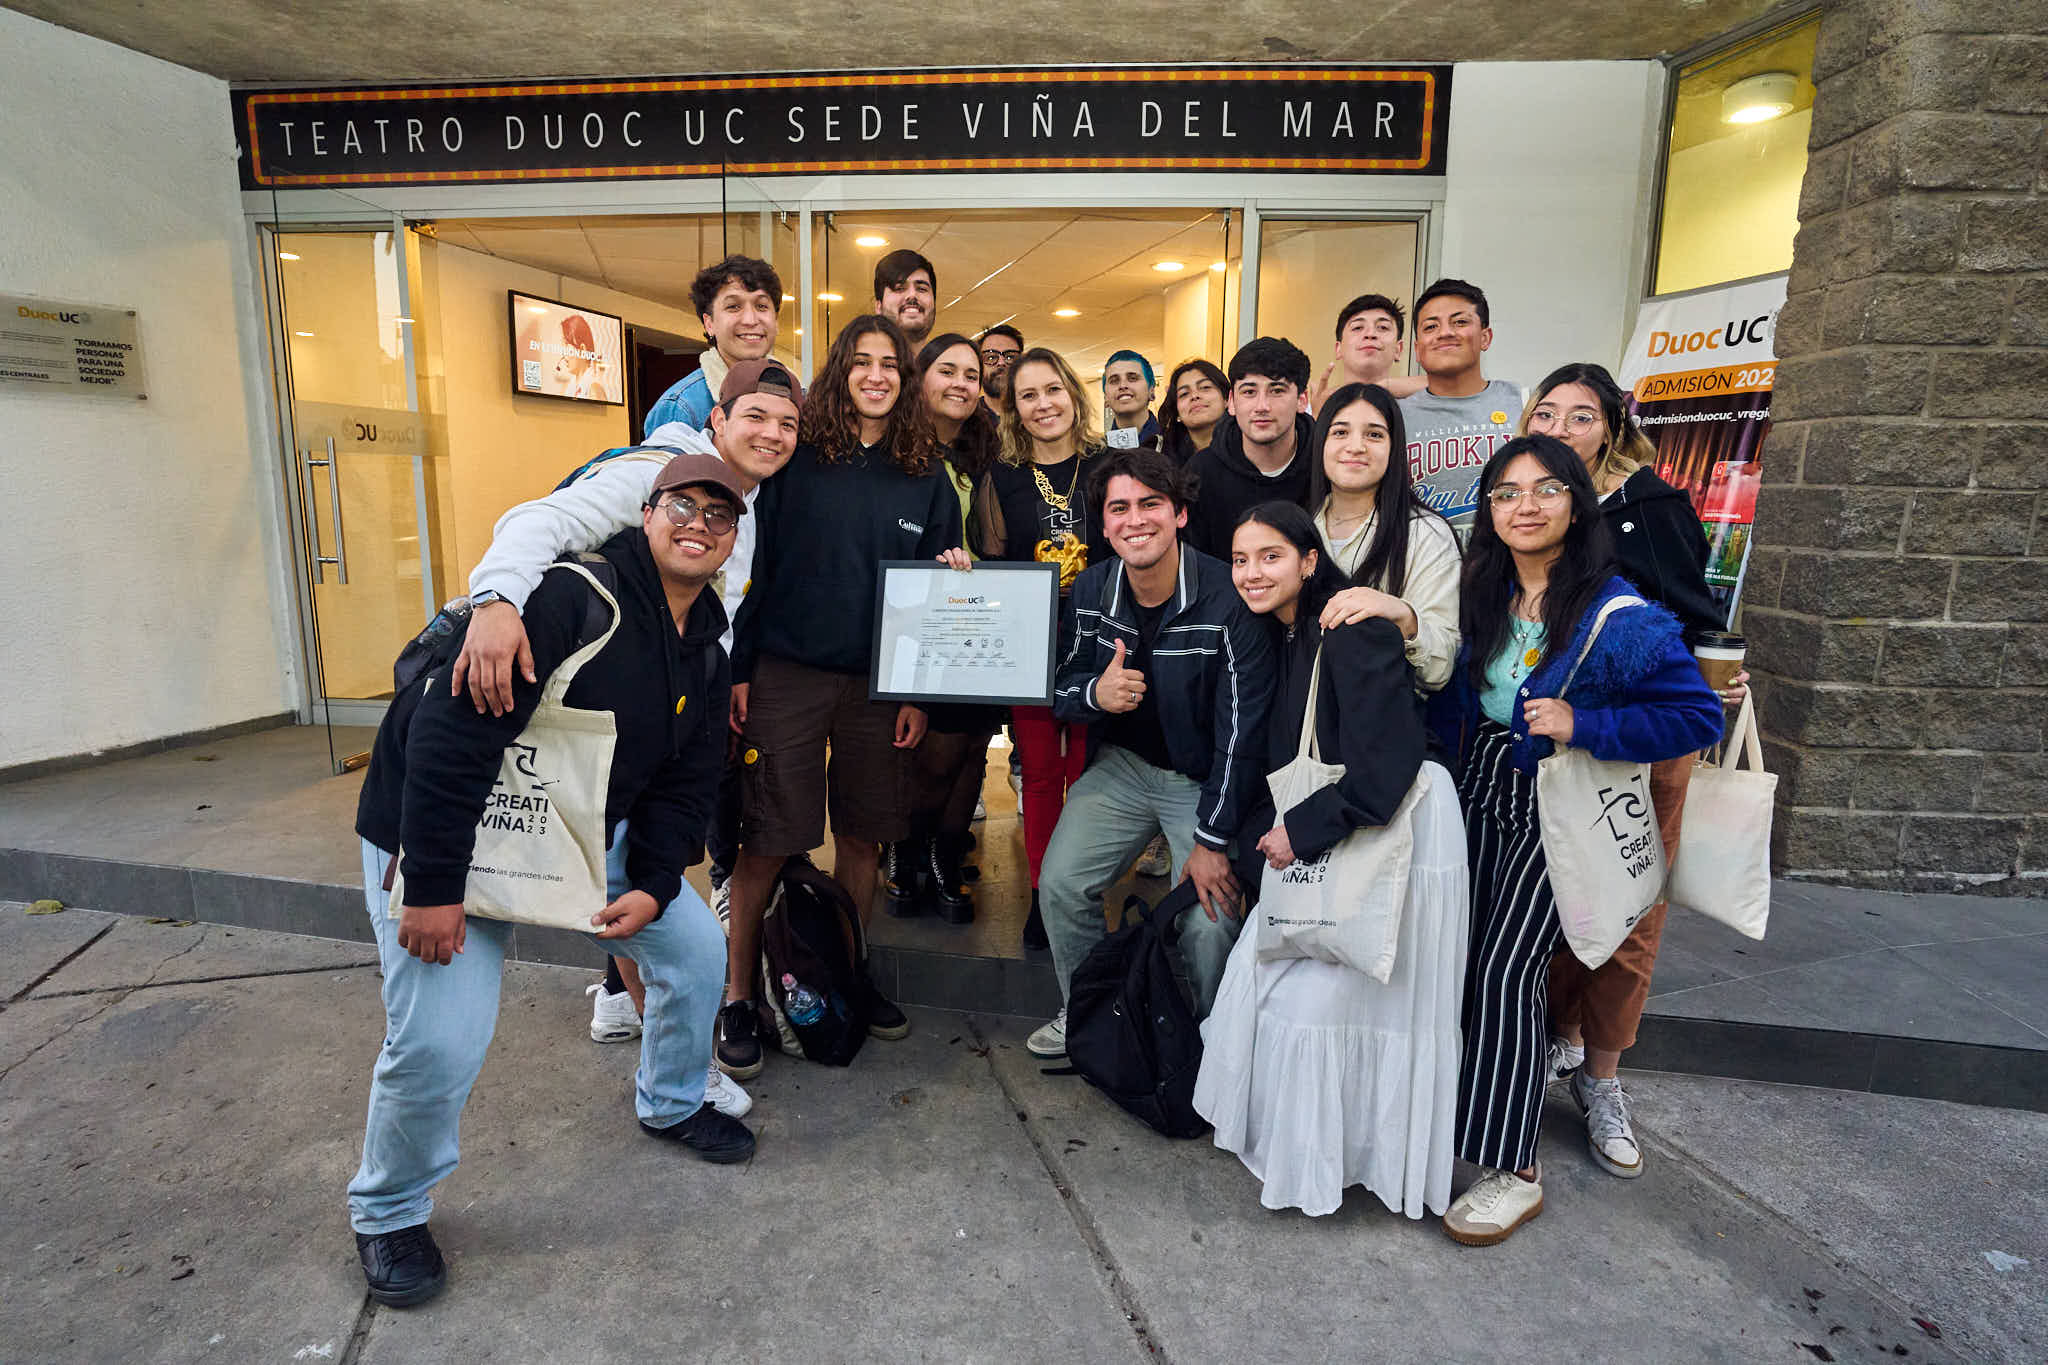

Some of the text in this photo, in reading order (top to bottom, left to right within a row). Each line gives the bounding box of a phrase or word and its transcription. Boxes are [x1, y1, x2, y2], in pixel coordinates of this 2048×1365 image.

[280, 93, 1395, 156] TEATRO DUOC UC SEDE VIÑA DEL MAR
[1642, 367, 1775, 398] ADMISIÓN 202
[1641, 407, 1770, 427] @admisionduocuc_vregi
[485, 792, 549, 813] CREATI
[480, 811, 525, 833] VIÑA
[509, 870, 541, 881] grandes
[542, 872, 564, 882] ideas
